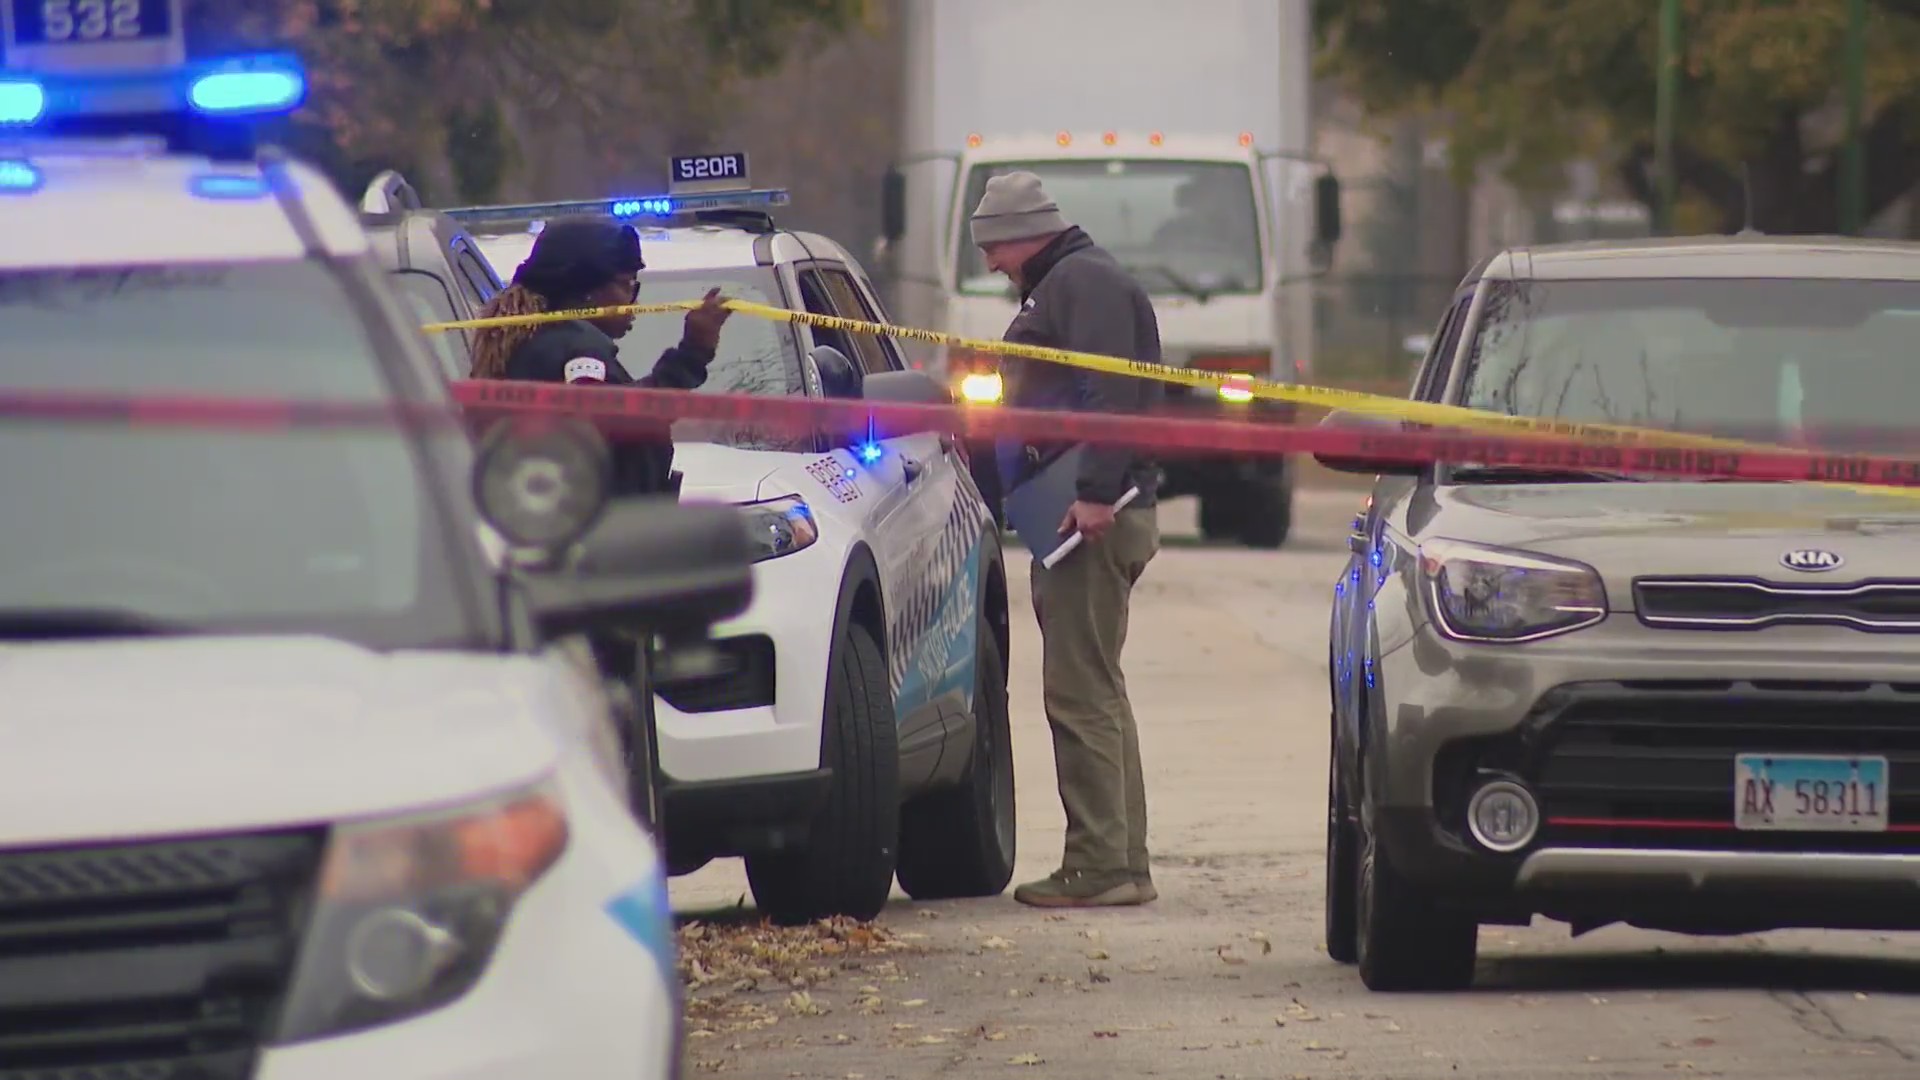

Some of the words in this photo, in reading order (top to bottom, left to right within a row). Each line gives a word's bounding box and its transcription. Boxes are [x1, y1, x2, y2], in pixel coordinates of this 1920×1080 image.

[44, 0, 141, 40] 532
[680, 155, 738, 179] 520R
[789, 312, 828, 328] POLICE
[1788, 551, 1835, 566] KIA
[1744, 778, 1775, 815] AX
[1794, 778, 1879, 817] 58311
